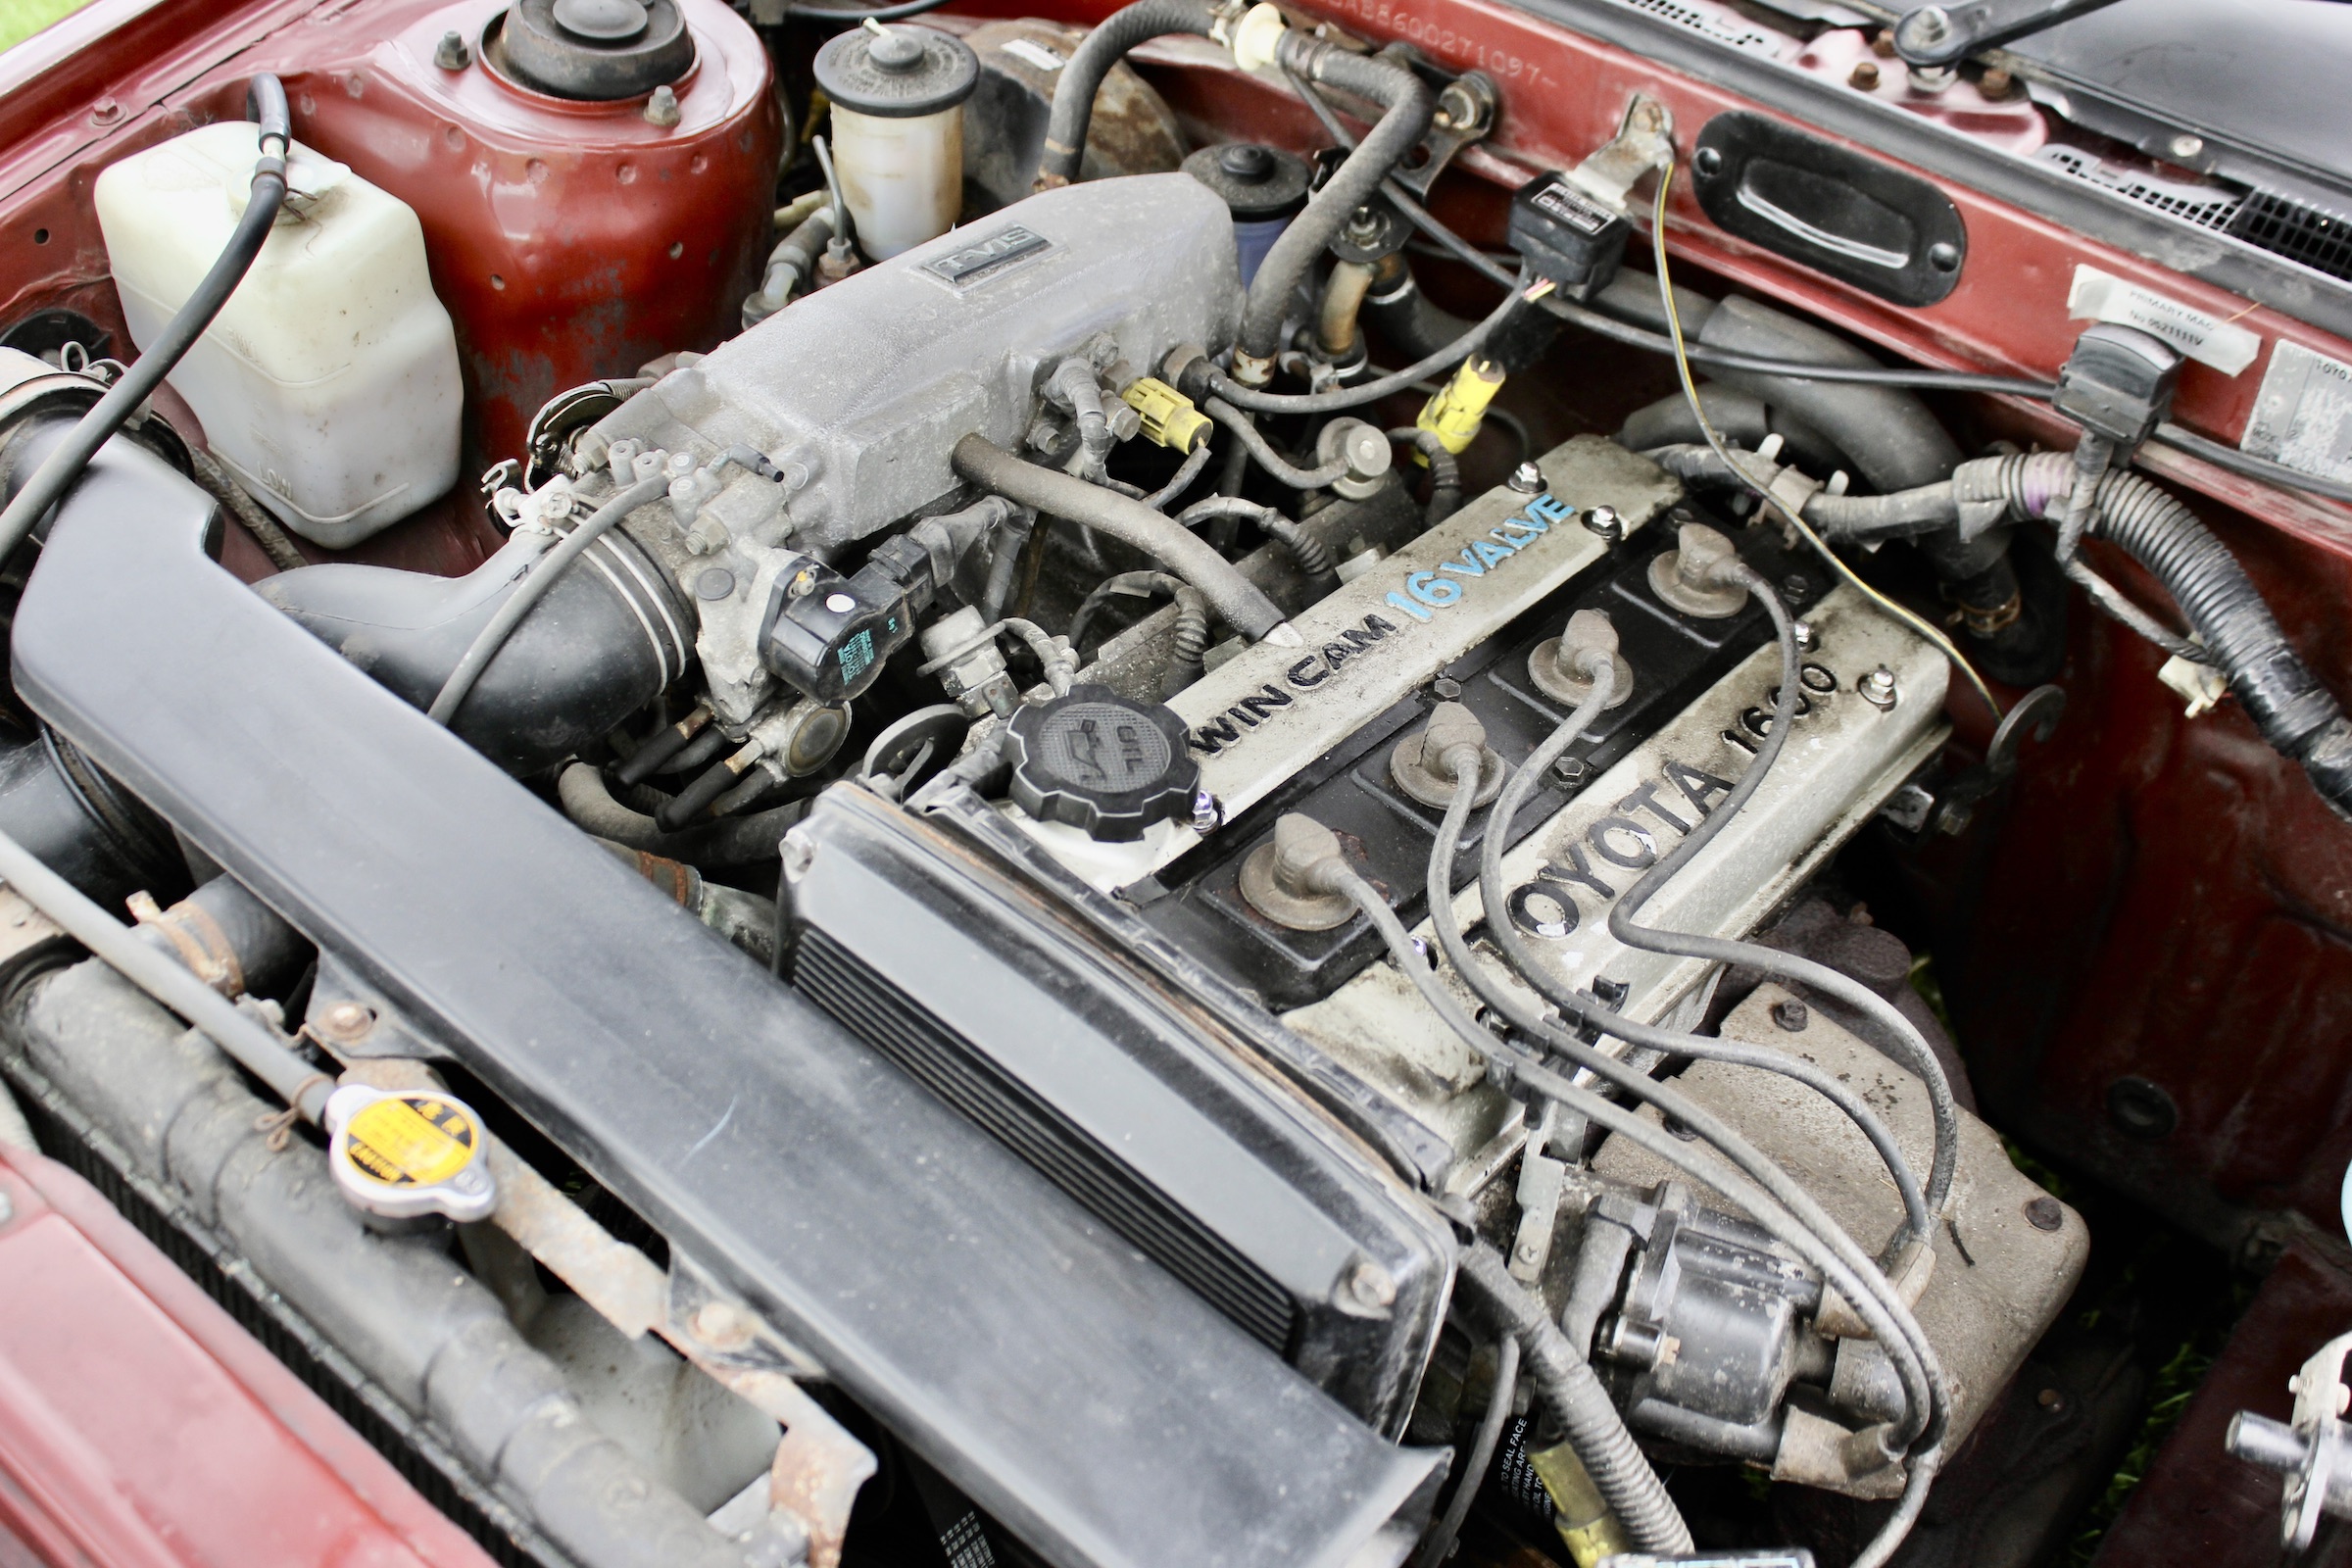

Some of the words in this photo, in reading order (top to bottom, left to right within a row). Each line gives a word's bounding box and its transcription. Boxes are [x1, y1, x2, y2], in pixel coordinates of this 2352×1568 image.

[937, 223, 1036, 270] T-VIS
[2315, 358, 2352, 384] TOYO
[257, 460, 293, 501] LOW
[1189, 683, 1295, 758] WIN
[1286, 612, 1399, 692] CAM
[1384, 569, 1463, 623] 16
[1439, 493, 1578, 578] VALVE
[1720, 662, 1838, 759] 1600
[1116, 725, 1145, 774] OIL
[1502, 1447, 1516, 1472] SEAL
[1509, 1417, 1528, 1446] FACE
[1515, 1439, 1527, 1469] ARE
[1522, 1462, 1536, 1491] HAND
